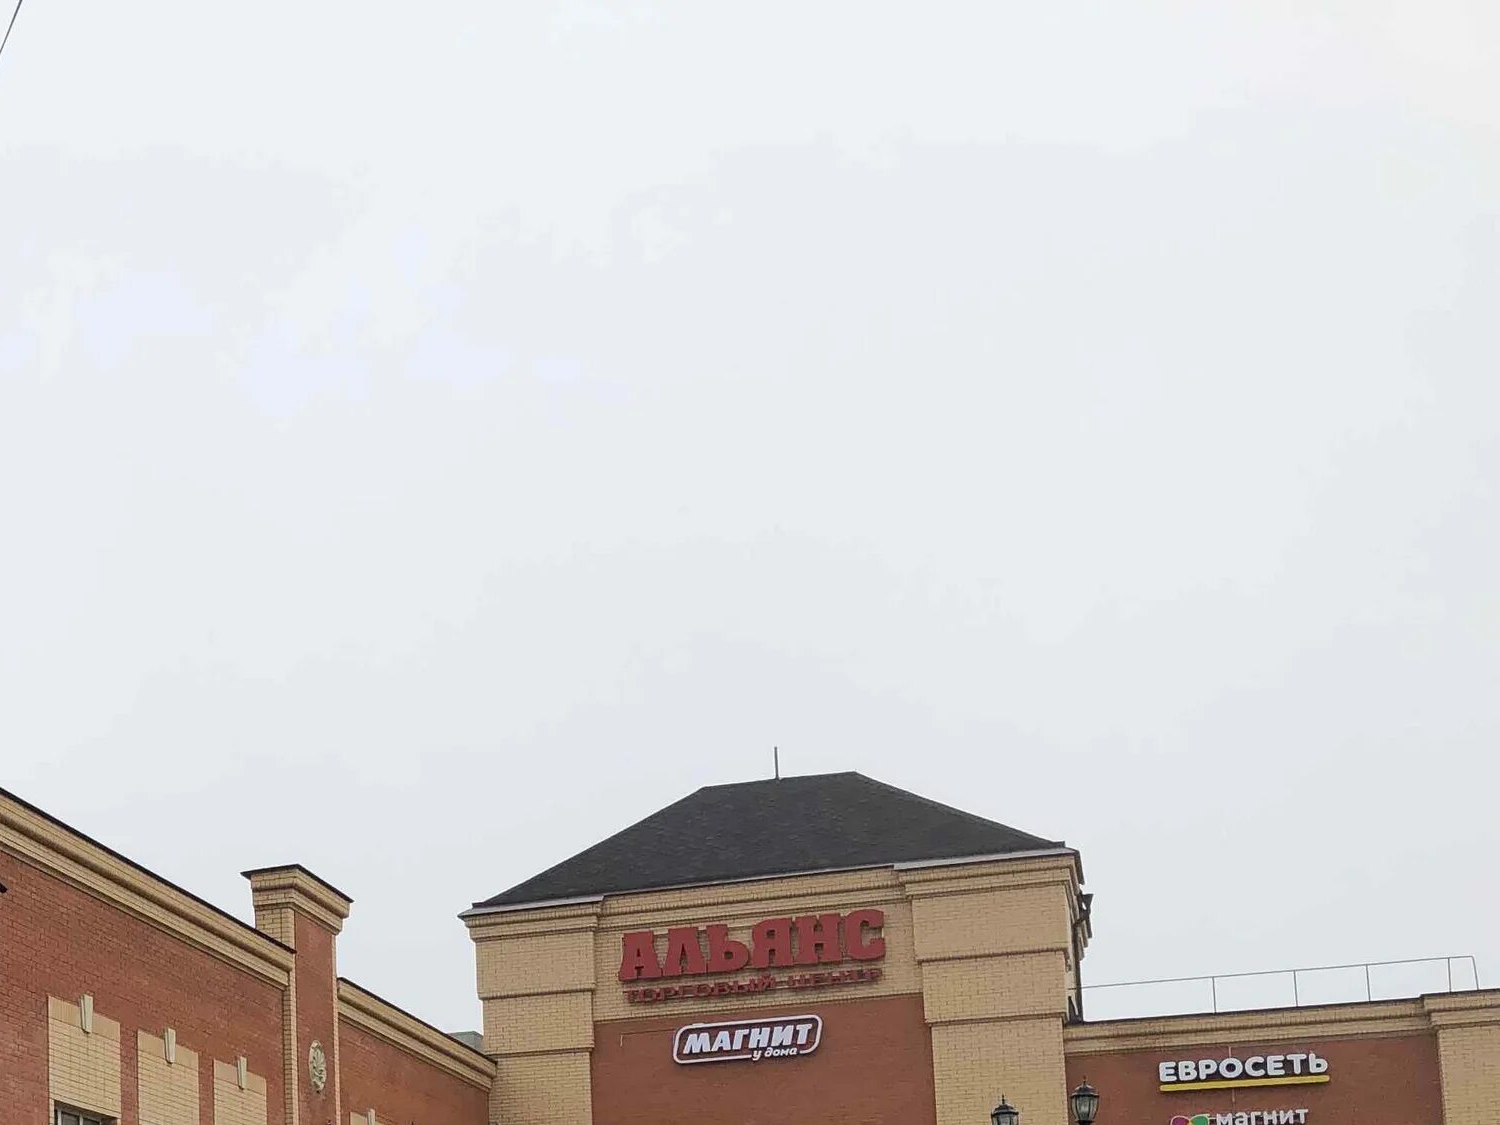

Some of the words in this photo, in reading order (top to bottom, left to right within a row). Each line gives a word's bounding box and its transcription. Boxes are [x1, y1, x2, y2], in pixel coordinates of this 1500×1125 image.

[618, 908, 886, 982] АЛЬЯНС
[622, 974, 777, 1003] ТОРГОВЫЙ
[787, 968, 883, 988] ЦЕНТР
[683, 1024, 812, 1054] МАГНИТ
[752, 1050, 762, 1061] у
[764, 1047, 797, 1057] дома
[1158, 1052, 1328, 1083] ЕВРОСЕТЬ
